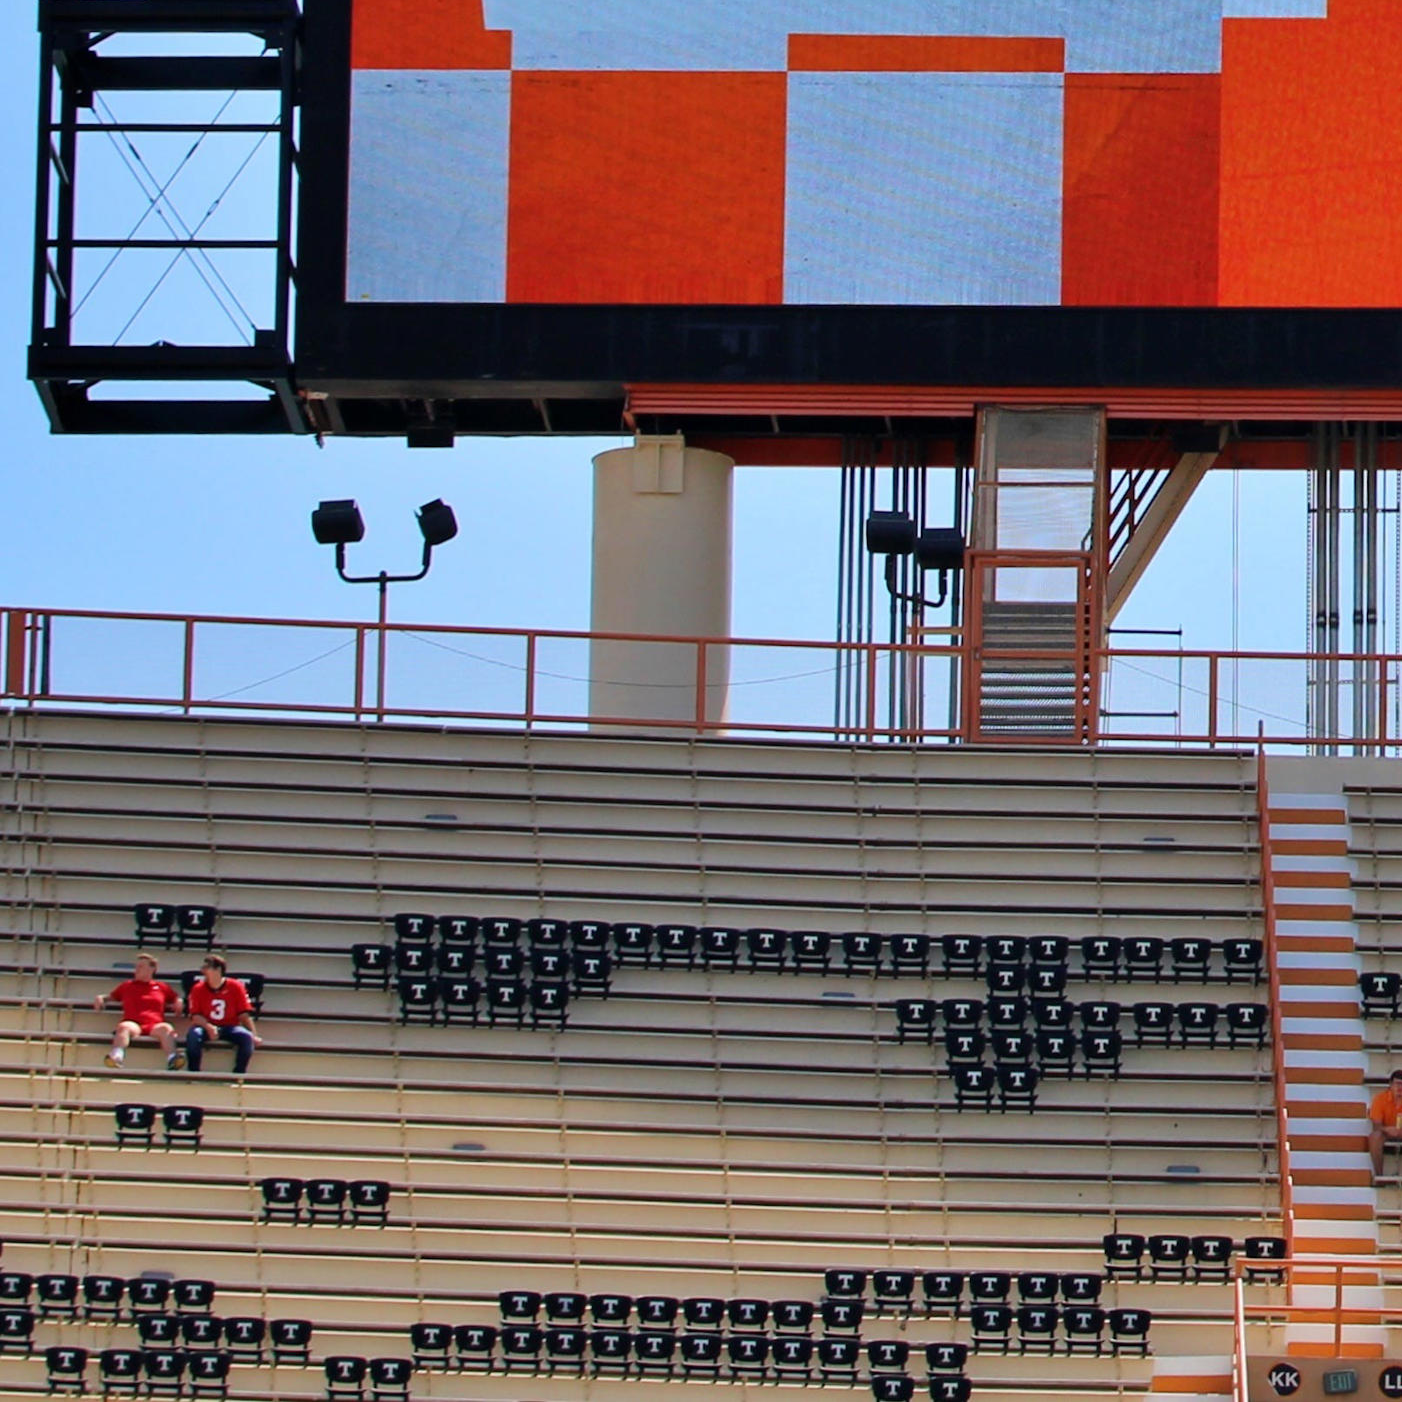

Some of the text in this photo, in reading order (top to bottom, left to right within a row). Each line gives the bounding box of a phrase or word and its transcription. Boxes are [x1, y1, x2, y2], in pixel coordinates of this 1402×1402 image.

[148, 909, 162, 922] T
[189, 910, 203, 924] T
[409, 918, 423, 932] T
[495, 923, 509, 936] T
[583, 926, 597, 939] T
[626, 928, 640, 942] T
[713, 932, 727, 945] T
[760, 934, 774, 947] T
[855, 937, 869, 951] T
[955, 940, 969, 953] T
[1042, 941, 1056, 954] T
[1094, 942, 1108, 955] T
[1236, 944, 1250, 957] T
[365, 949, 379, 963] T
[1373, 977, 1387, 991] T
[453, 985, 468, 999] T
[542, 989, 556, 1003] T
[210, 999, 226, 1021] 3
[910, 1004, 924, 1018] T
[1146, 1008, 1161, 1021] T
[1239, 1008, 1253, 1022] T
[1095, 1039, 1109, 1053] T
[967, 1071, 981, 1085] T
[1011, 1072, 1025, 1086] T
[128, 1108, 143, 1122] T
[176, 1110, 190, 1124] T
[275, 1183, 290, 1197] T
[319, 1184, 334, 1198] T
[362, 1186, 377, 1200] T
[1117, 1240, 1131, 1254] T
[1204, 1241, 1219, 1255] T
[1259, 1242, 1273, 1256] T
[4, 1278, 19, 1292] T
[96, 1281, 111, 1295] T
[838, 1275, 853, 1289] T
[886, 1276, 901, 1290] T
[982, 1277, 997, 1291] T
[1031, 1278, 1046, 1292] T
[186, 1285, 201, 1300] T
[513, 1296, 527, 1311] T
[603, 1299, 618, 1313] T
[697, 1303, 711, 1317] T
[6, 1315, 21, 1330] T
[1123, 1314, 1137, 1328] T
[284, 1324, 298, 1338] T
[424, 1328, 439, 1343] T
[604, 1336, 619, 1351] T
[785, 1343, 800, 1357] T
[114, 1355, 129, 1369] T
[202, 1357, 217, 1372] T
[338, 1362, 353, 1376] T
[383, 1363, 398, 1378] T
[1271, 1371, 1299, 1387] KK
[1329, 1373, 1350, 1391] EXIT
[886, 1381, 900, 1395] T
[943, 1383, 958, 1397] T
